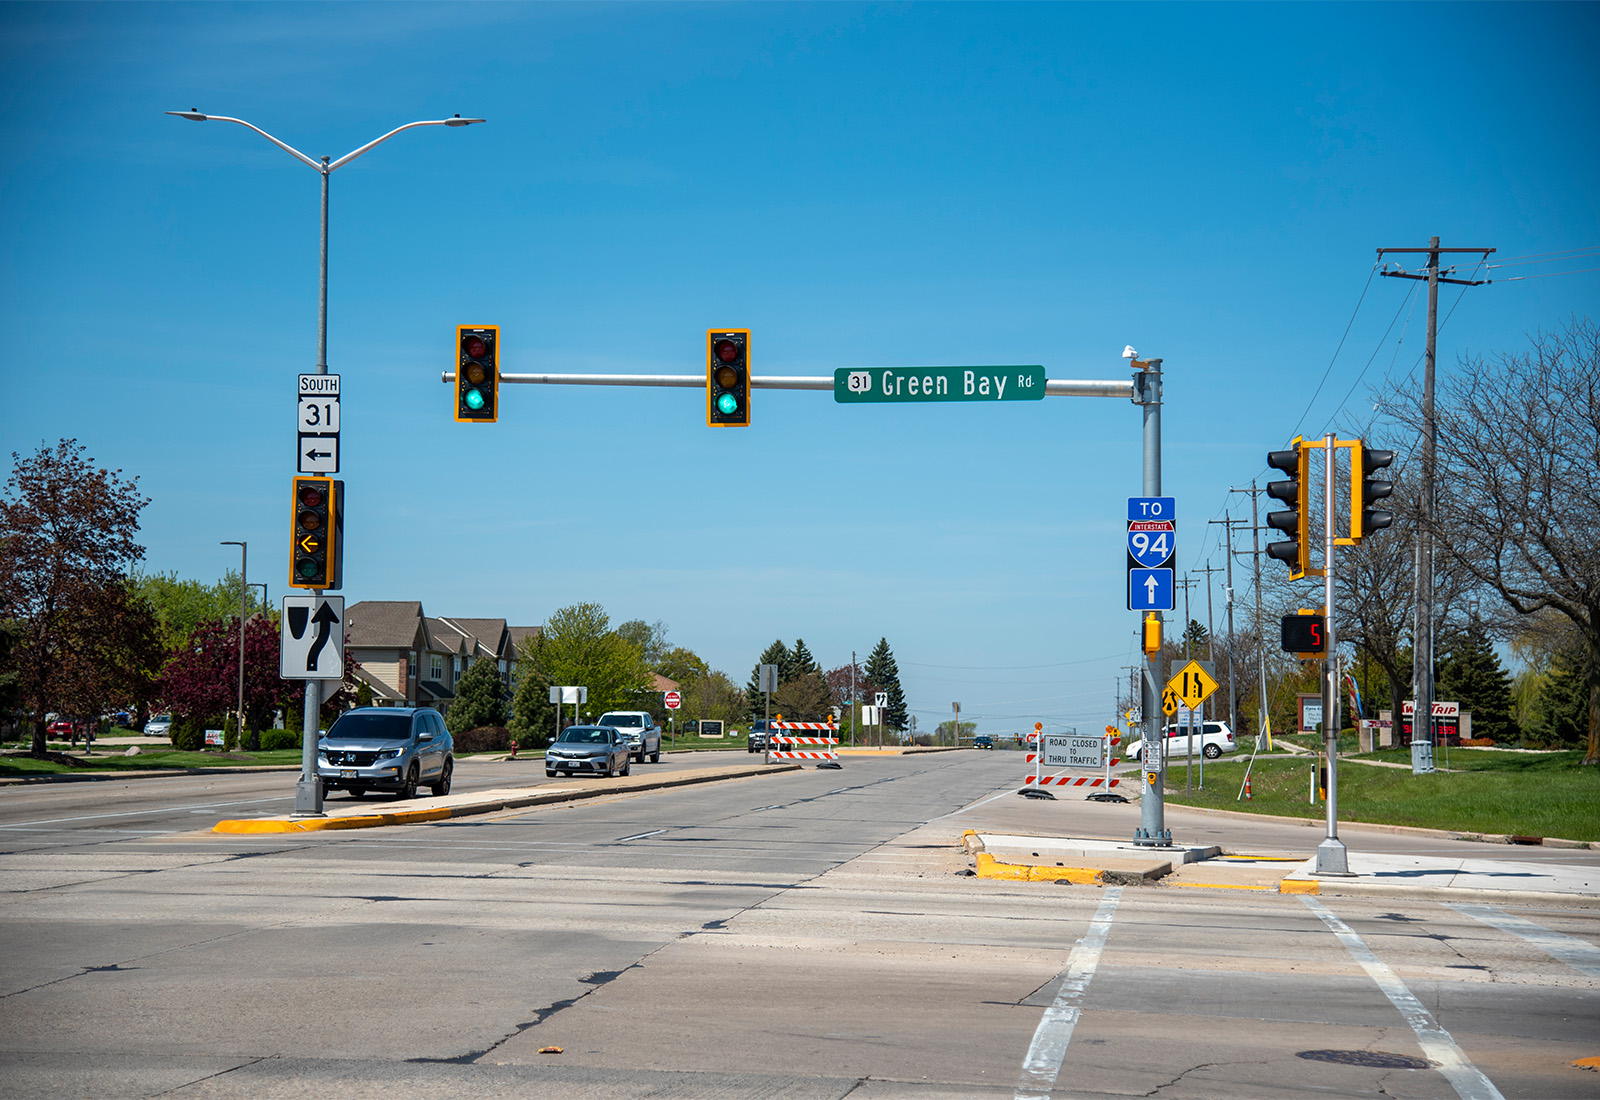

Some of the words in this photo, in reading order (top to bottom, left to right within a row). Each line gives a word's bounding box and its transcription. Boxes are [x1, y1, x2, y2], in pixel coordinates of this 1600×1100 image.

[301, 377, 337, 391] SOUTH
[851, 375, 868, 389] 31
[882, 370, 948, 396] Green
[963, 370, 1008, 400] Bay
[305, 403, 331, 426] 31
[1139, 502, 1162, 516] TO
[1134, 523, 1168, 531] INTERSTATE
[1131, 533, 1169, 558] 94
[1310, 623, 1321, 646] 5
[1049, 738, 1067, 747] ROAD
[1072, 739, 1098, 748] CLOSED
[1049, 755, 1067, 763] THRU
[1070, 756, 1097, 765] TRAFFIC
